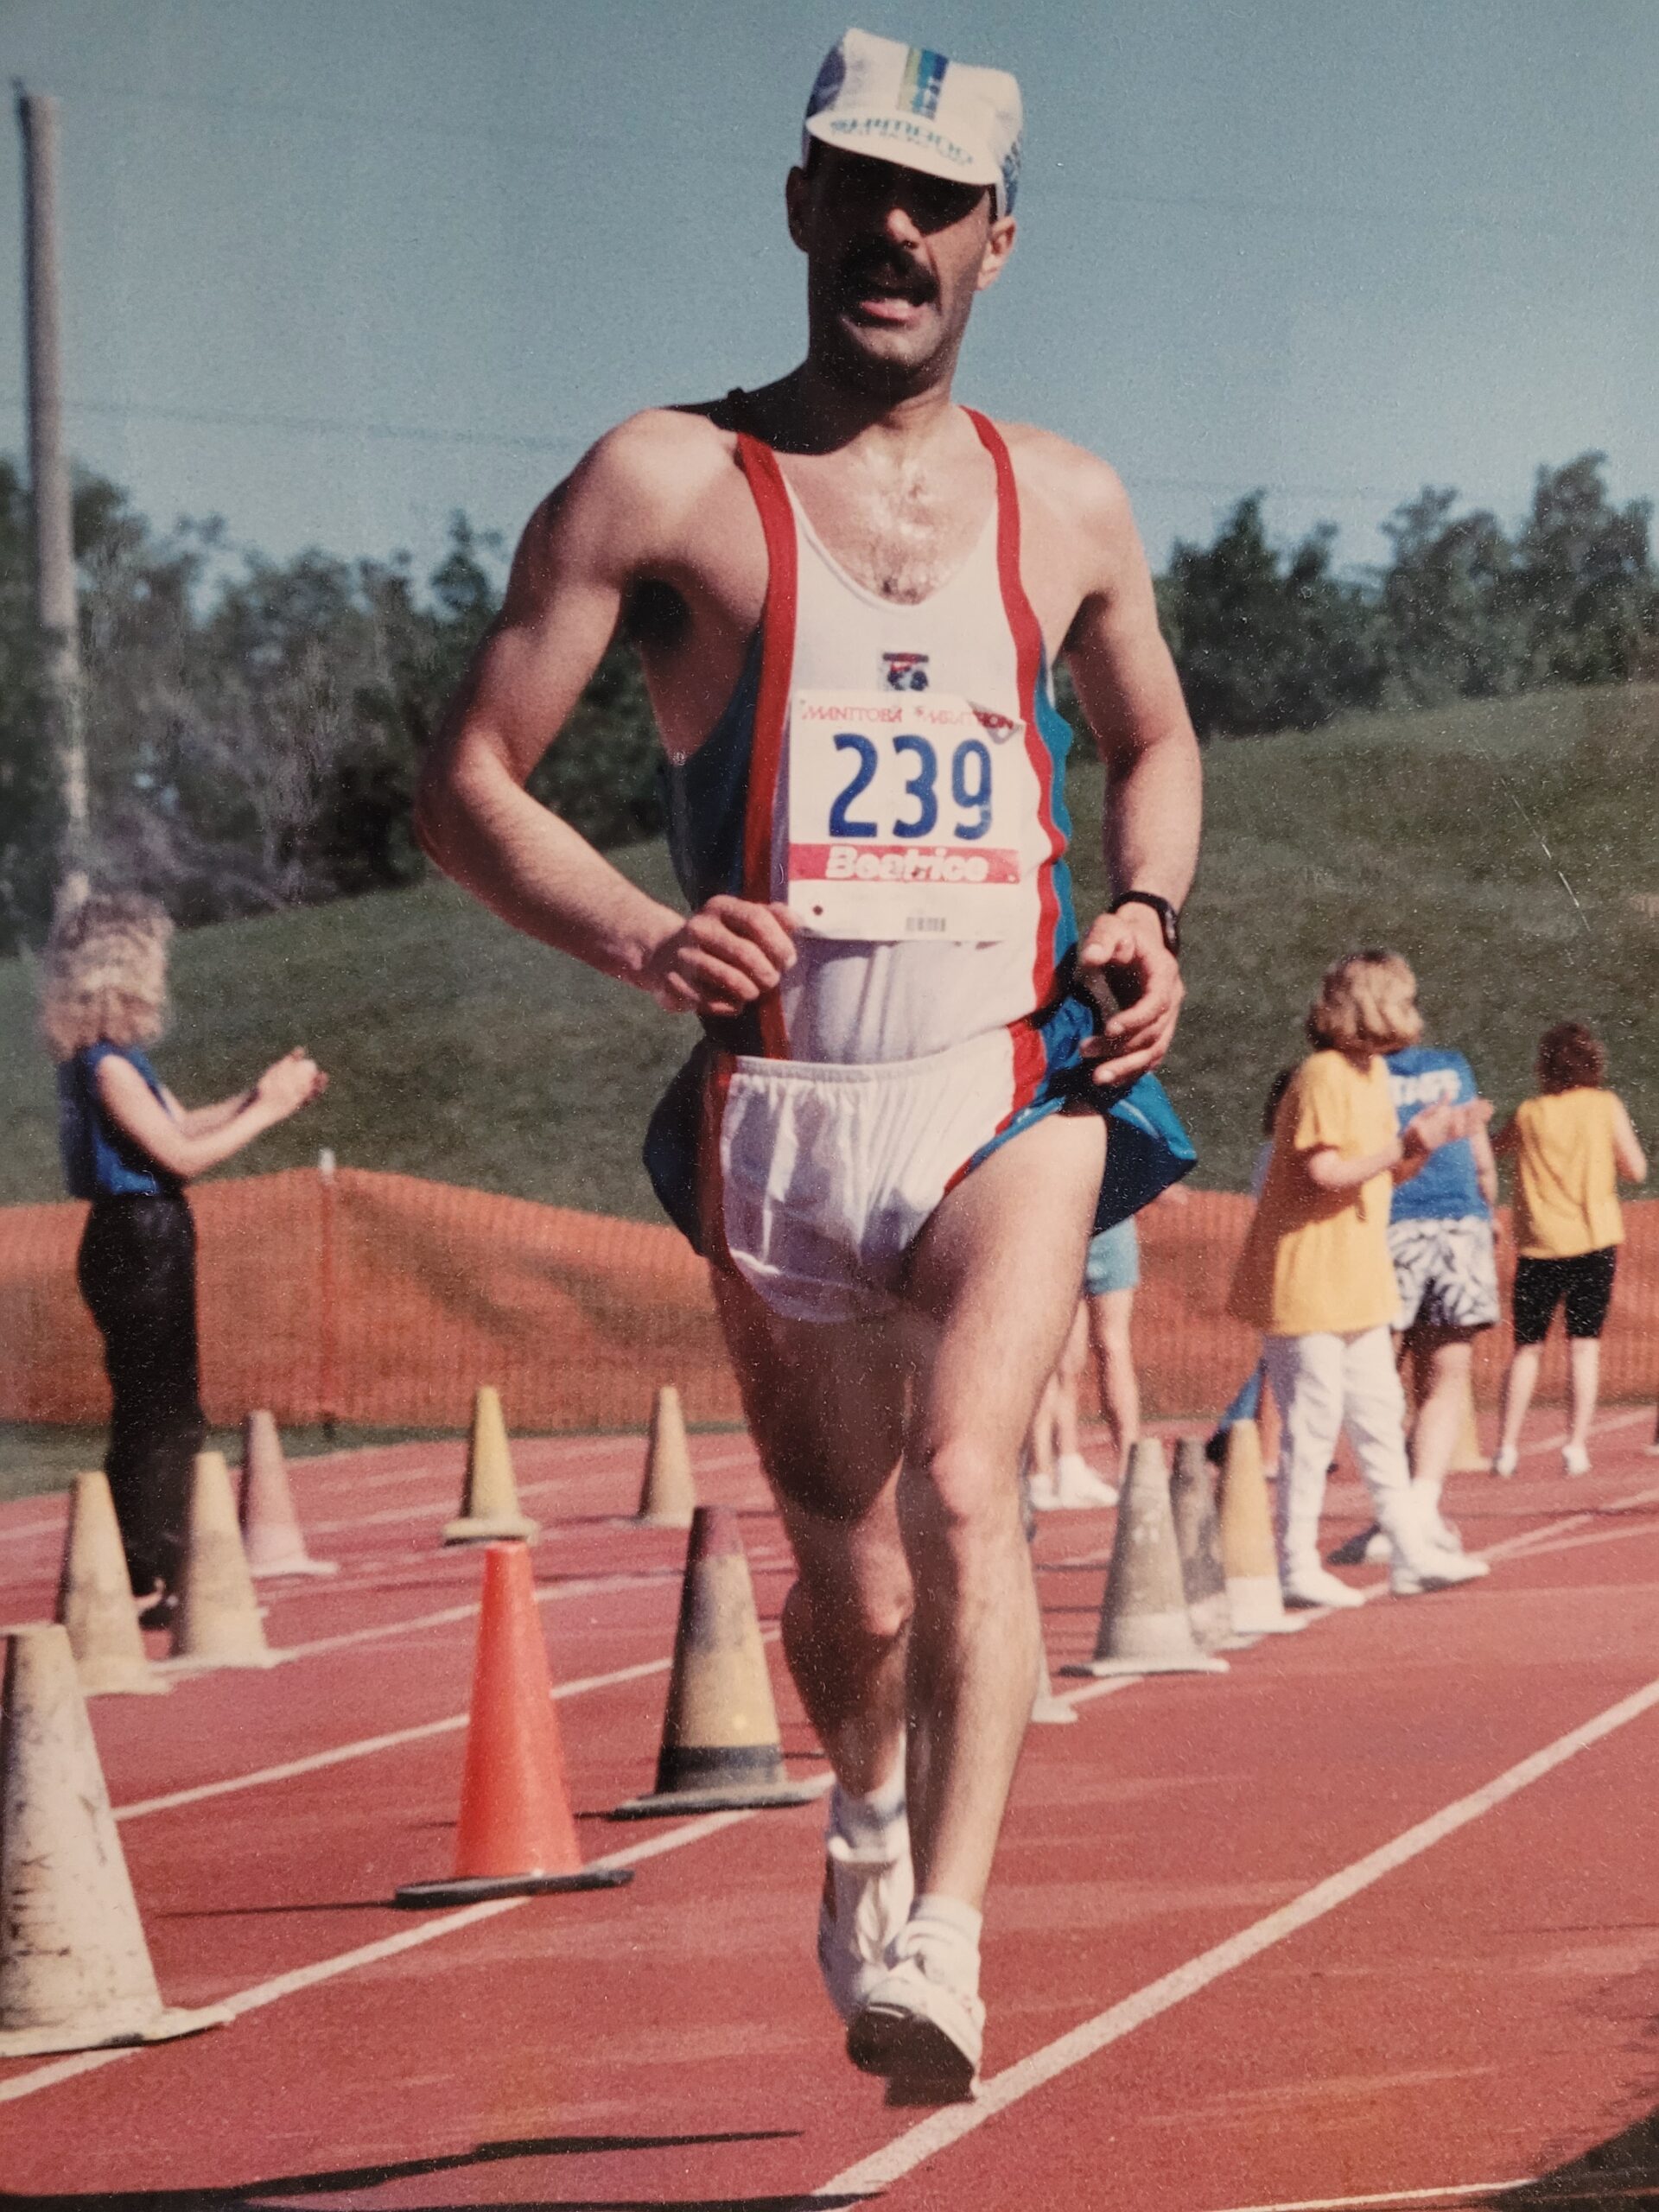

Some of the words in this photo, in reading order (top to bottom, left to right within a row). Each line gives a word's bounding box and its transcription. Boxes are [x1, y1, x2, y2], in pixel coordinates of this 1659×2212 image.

[802, 704, 903, 723] MANITOBA
[829, 733, 991, 840] 239
[825, 844, 989, 883] Beatrice
